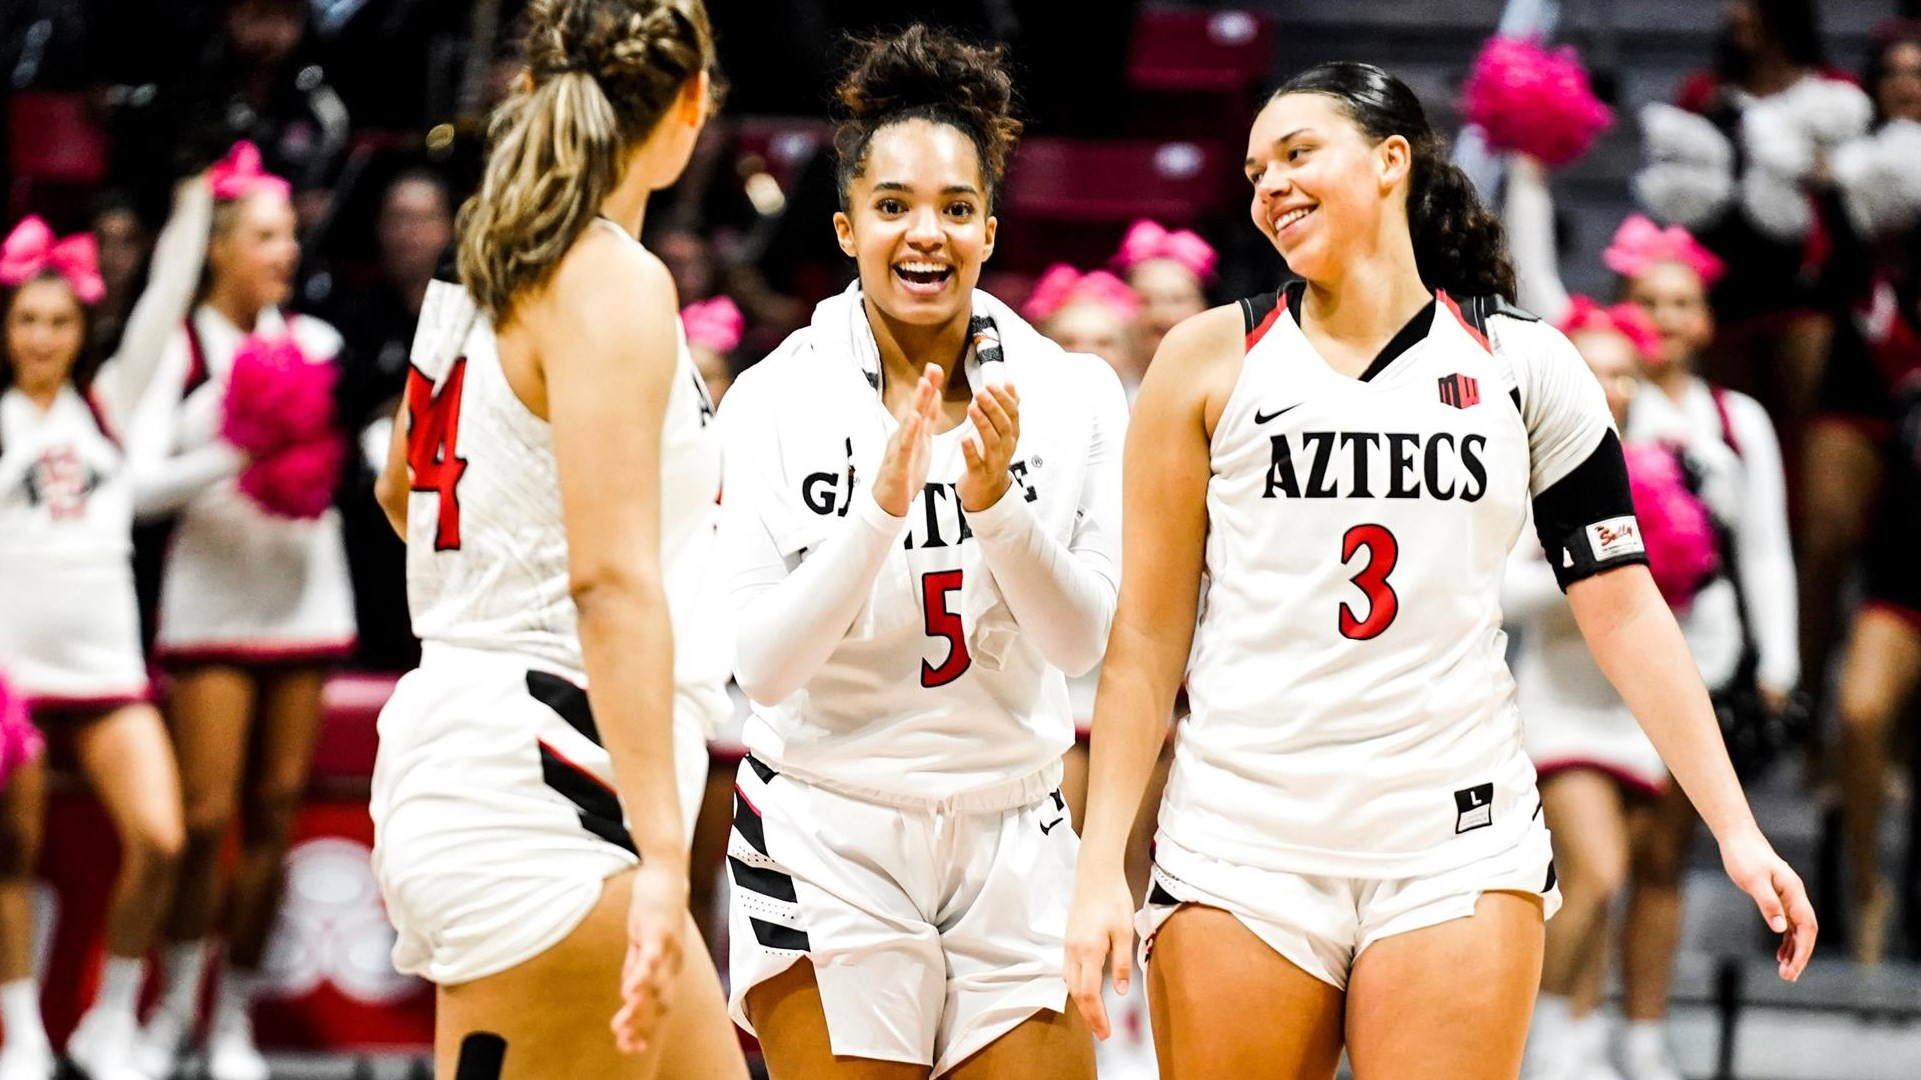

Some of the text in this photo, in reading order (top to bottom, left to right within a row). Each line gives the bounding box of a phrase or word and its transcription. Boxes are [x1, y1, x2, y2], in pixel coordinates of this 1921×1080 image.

[1262, 431, 1488, 502] AZTECS
[921, 569, 972, 688] 5
[1338, 523, 1399, 641] 3
[1470, 790, 1482, 806] L
